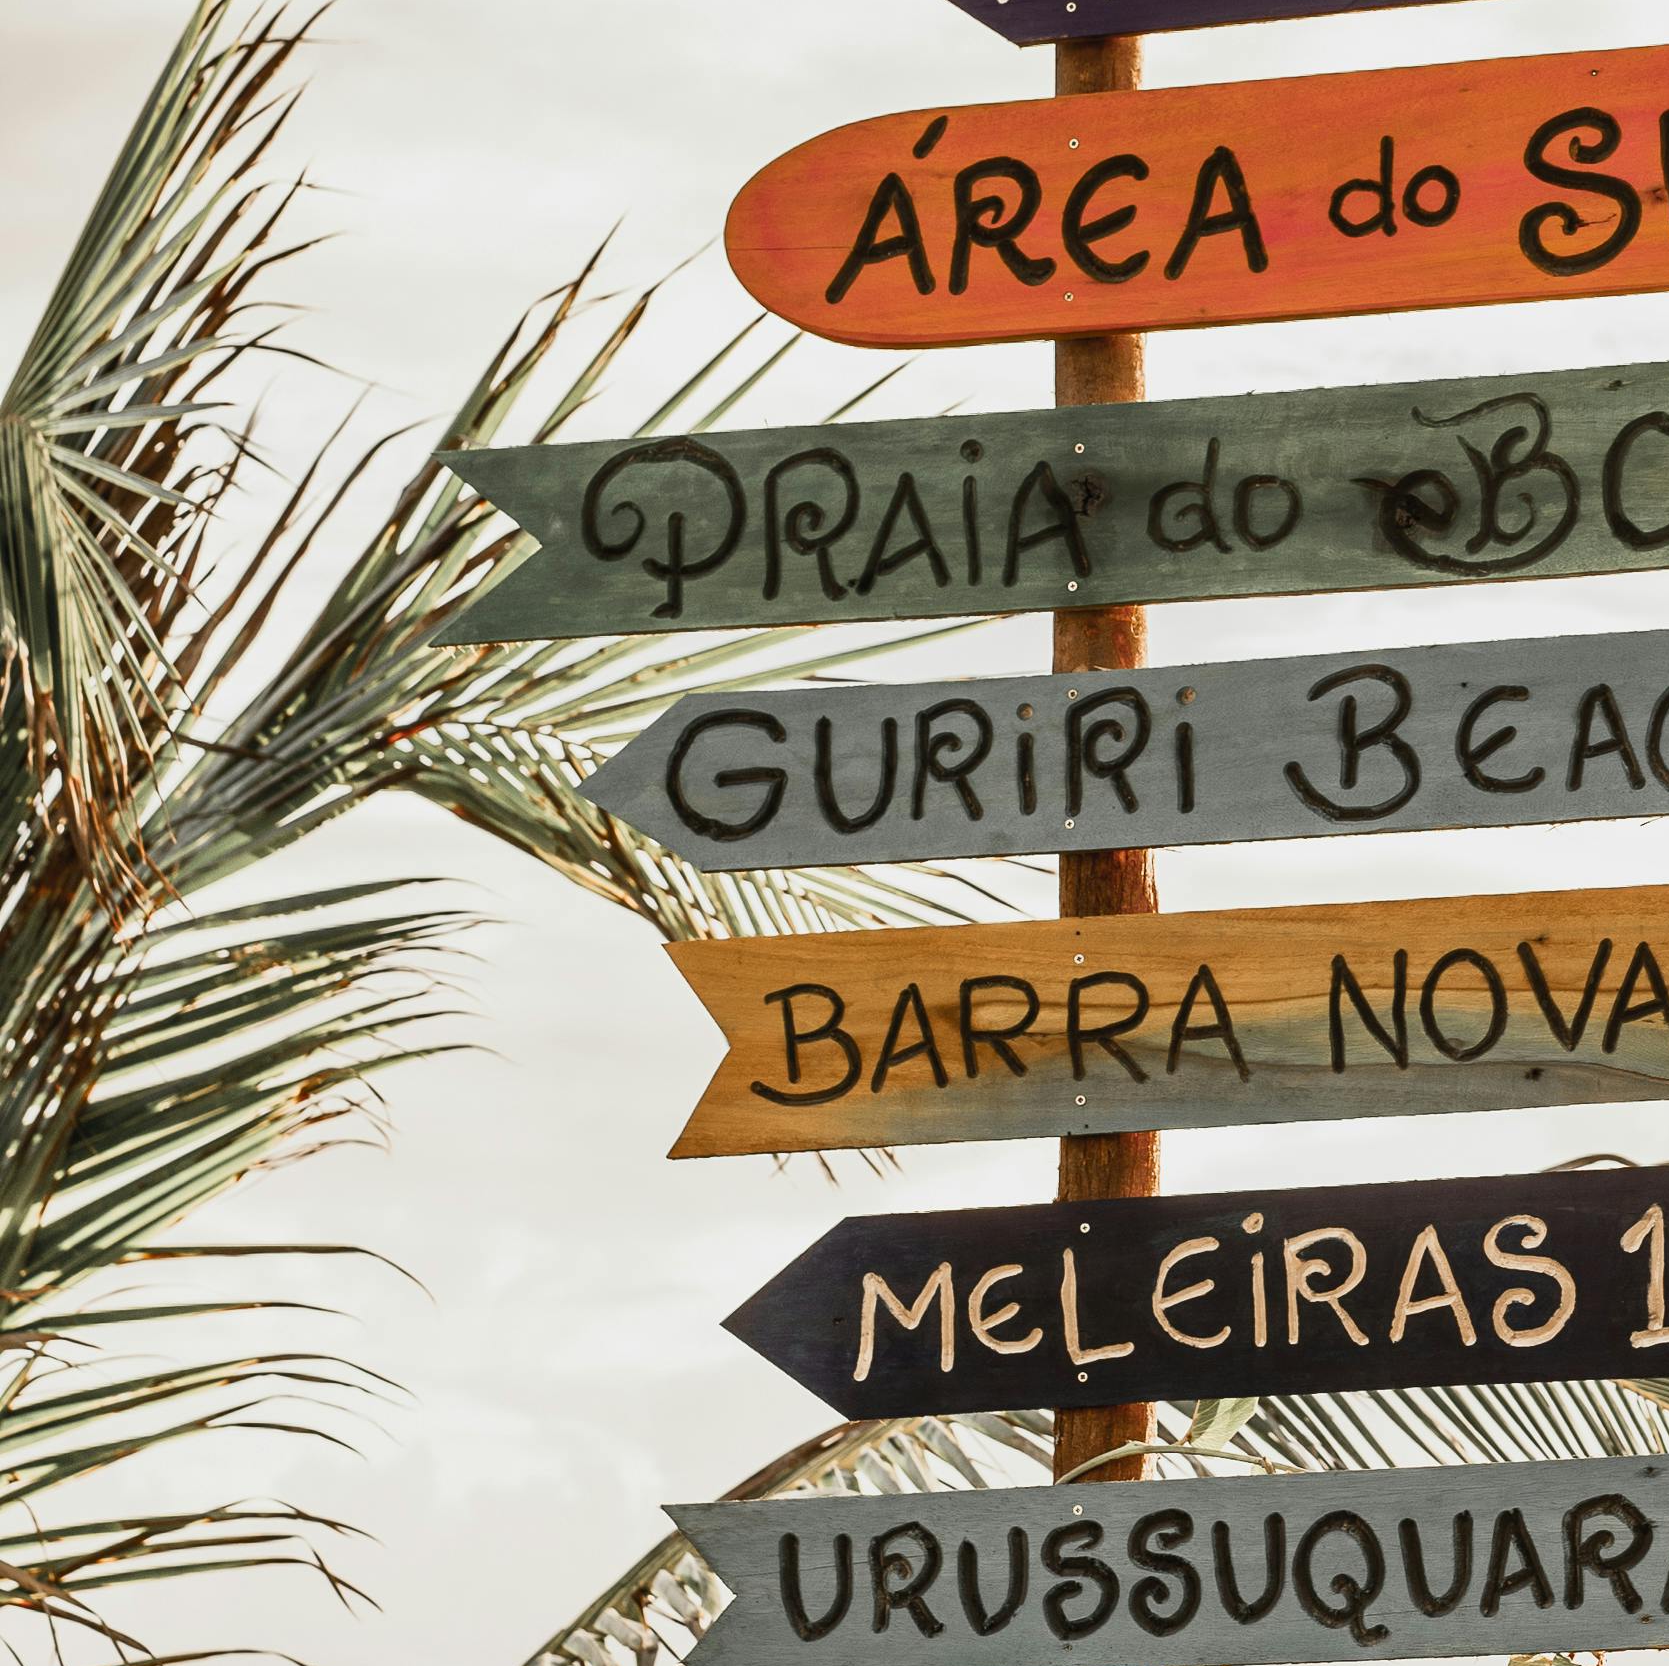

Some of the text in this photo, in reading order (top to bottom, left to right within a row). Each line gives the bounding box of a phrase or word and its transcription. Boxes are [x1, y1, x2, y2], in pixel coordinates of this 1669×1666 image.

[825, 116, 1268, 304] ÁREA
[1328, 135, 1460, 237] do
[1148, 438, 1303, 554] do
[751, 965, 1251, 1107] BARRA
